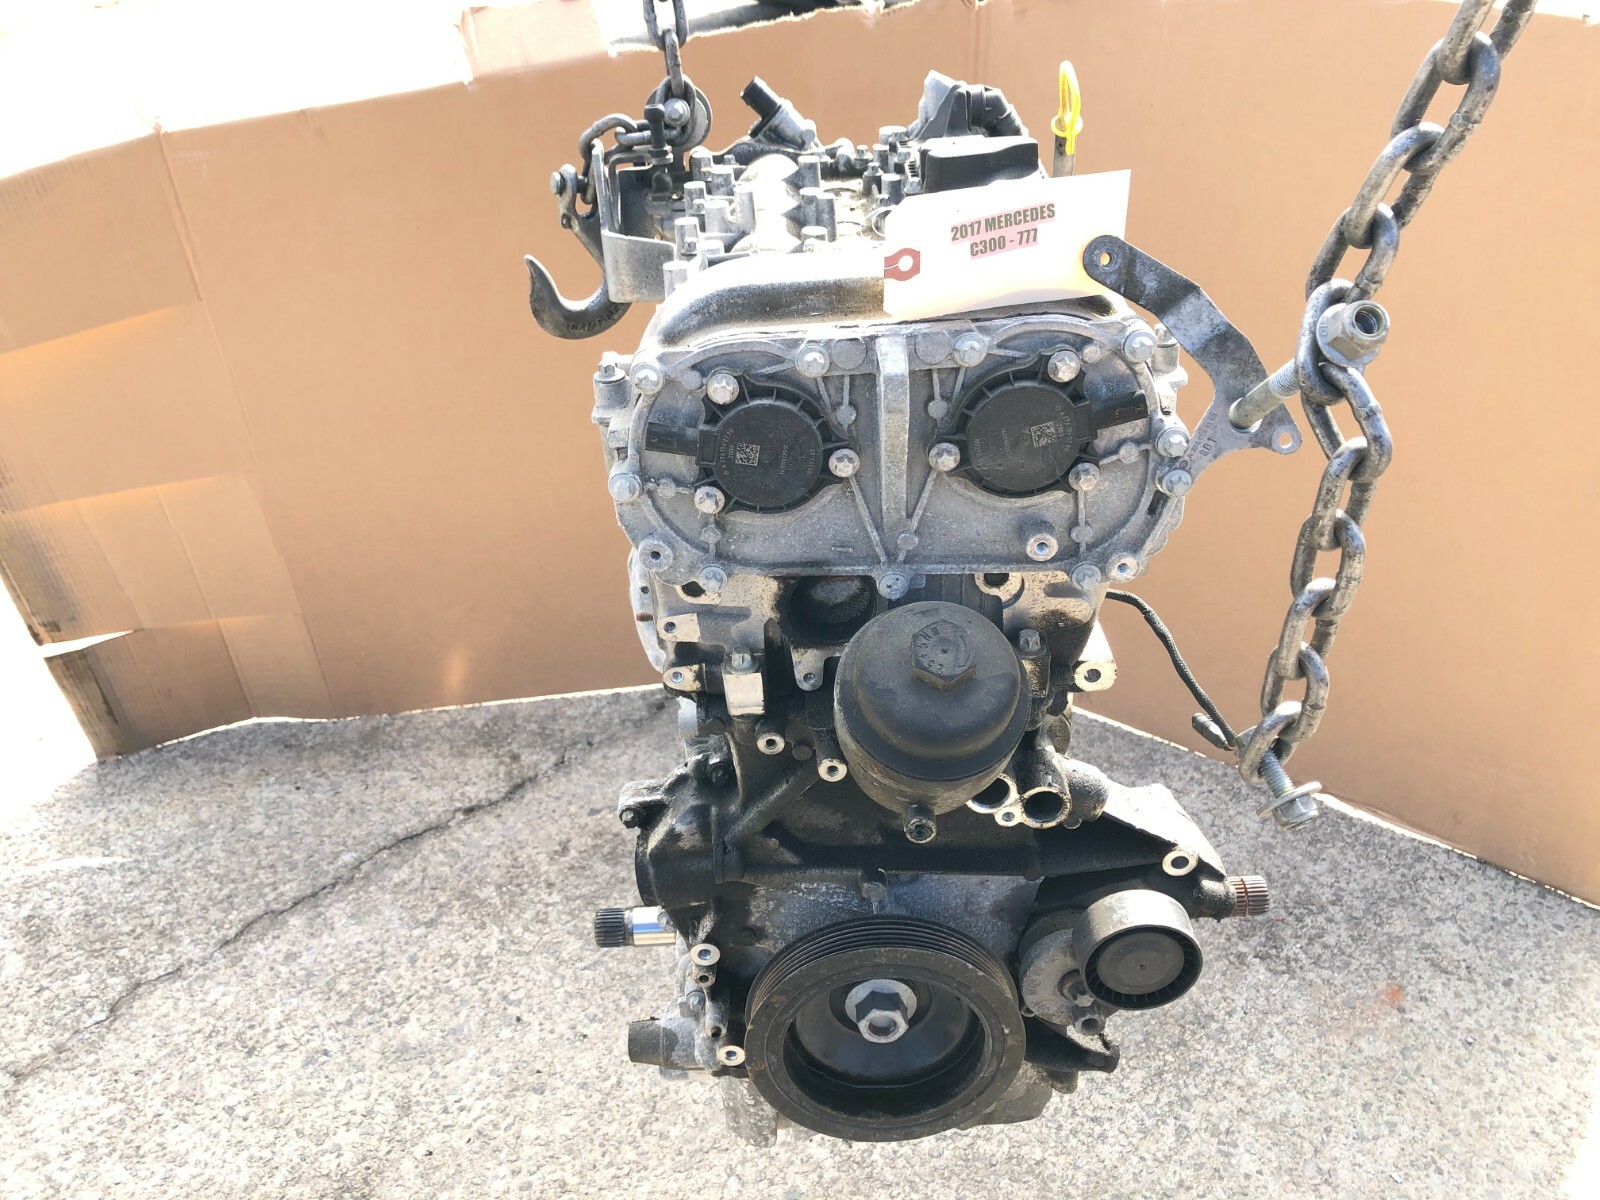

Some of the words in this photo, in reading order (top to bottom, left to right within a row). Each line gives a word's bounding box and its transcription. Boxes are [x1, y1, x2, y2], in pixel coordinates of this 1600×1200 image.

[951, 220, 982, 242] 2017
[984, 203, 1056, 233] MERCEDES
[970, 235, 1006, 257] C300
[1017, 228, 1038, 246] 777
